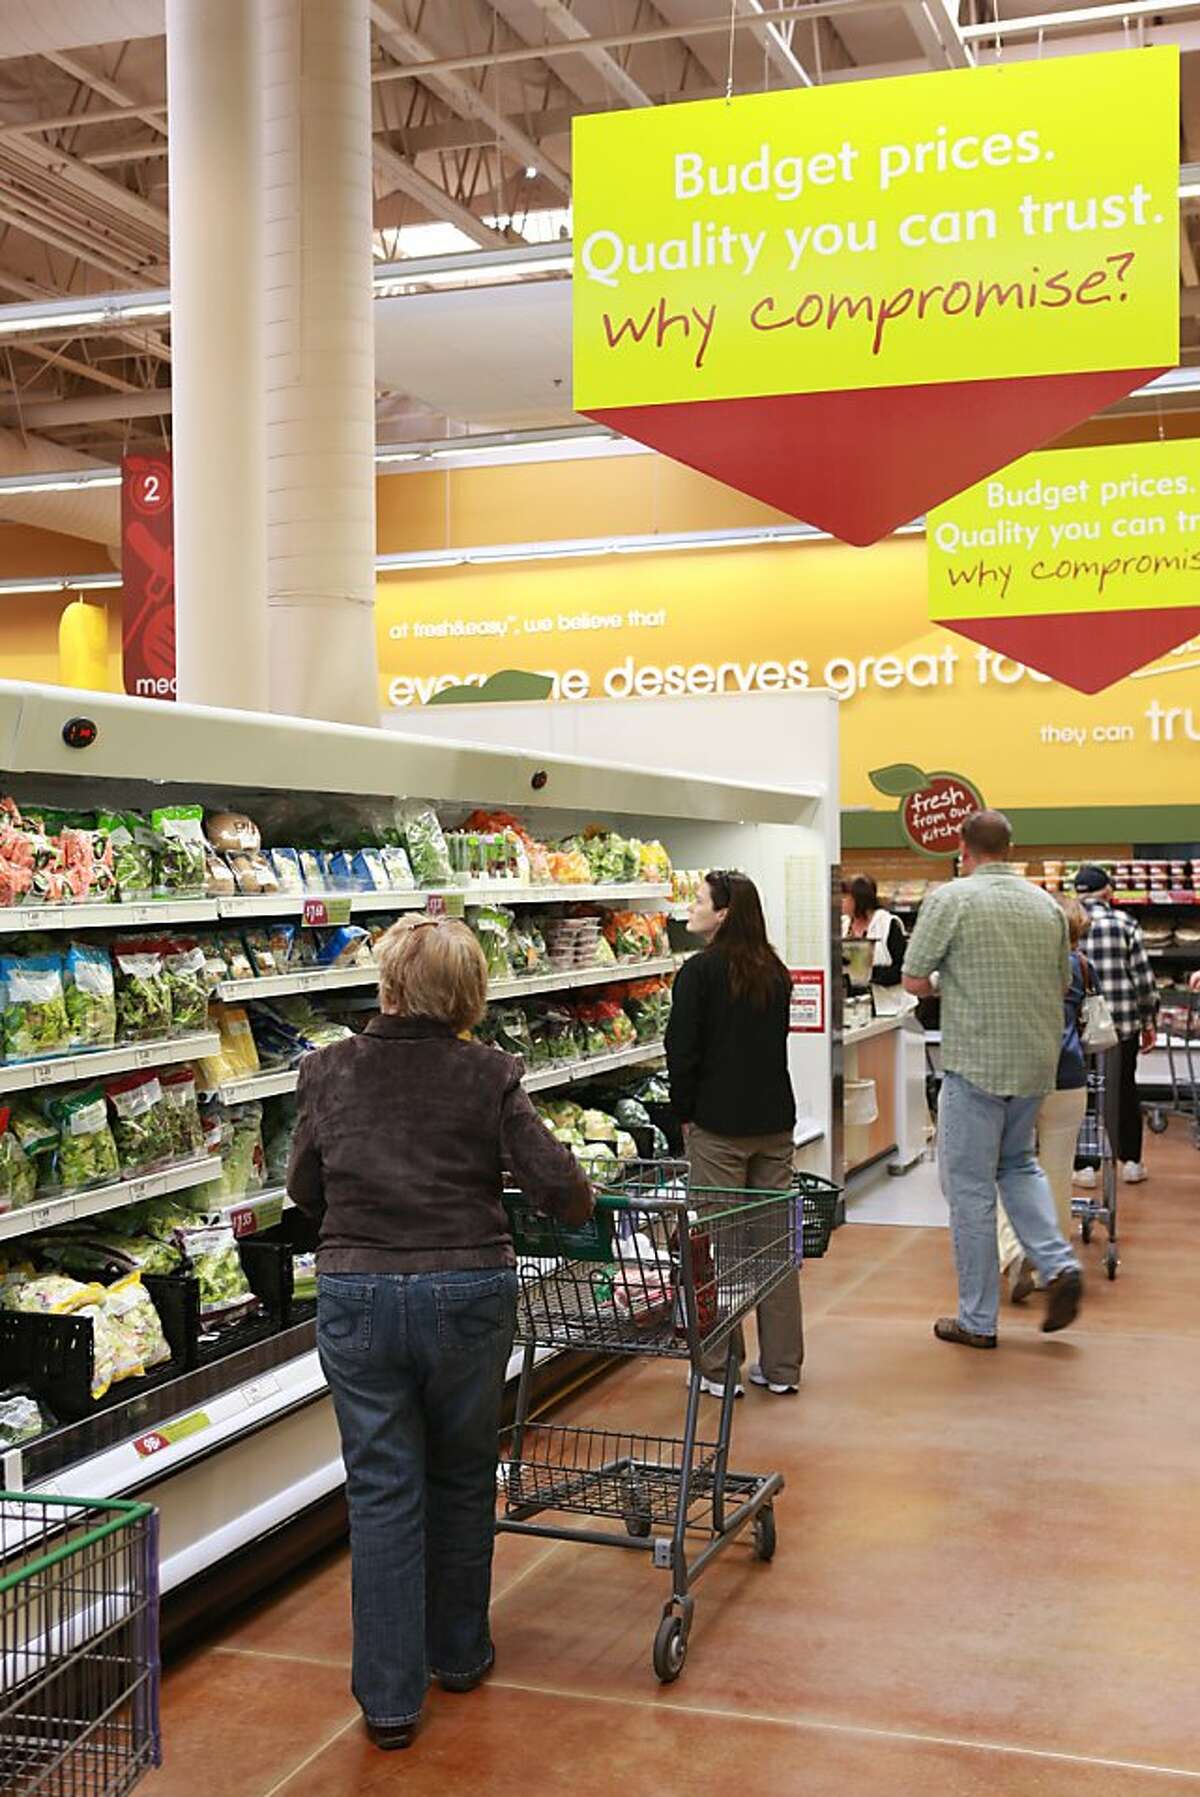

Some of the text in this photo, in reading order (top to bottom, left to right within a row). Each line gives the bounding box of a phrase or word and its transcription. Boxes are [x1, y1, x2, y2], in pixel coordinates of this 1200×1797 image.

[674, 125, 1055, 202] Budget prices.
[581, 184, 1164, 288] Quality you can trust.
[602, 252, 1135, 369] why compromise?
[144, 476, 160, 502] 2
[986, 473, 1196, 511] Budget prices.
[934, 518, 1041, 555] Quality
[1048, 521, 1102, 549] you
[1111, 515, 1167, 539] can
[948, 560, 1012, 599] why
[389, 623, 409, 640] at
[523, 616, 554, 634] we
[557, 611, 624, 633] believe
[626, 607, 668, 628] that
[603, 656, 809, 698] deserves
[823, 645, 959, 702] great
[1040, 721, 1087, 747] they
[1092, 724, 1135, 743] can
[911, 785, 965, 814] fresh
[912, 803, 973, 829] from our
